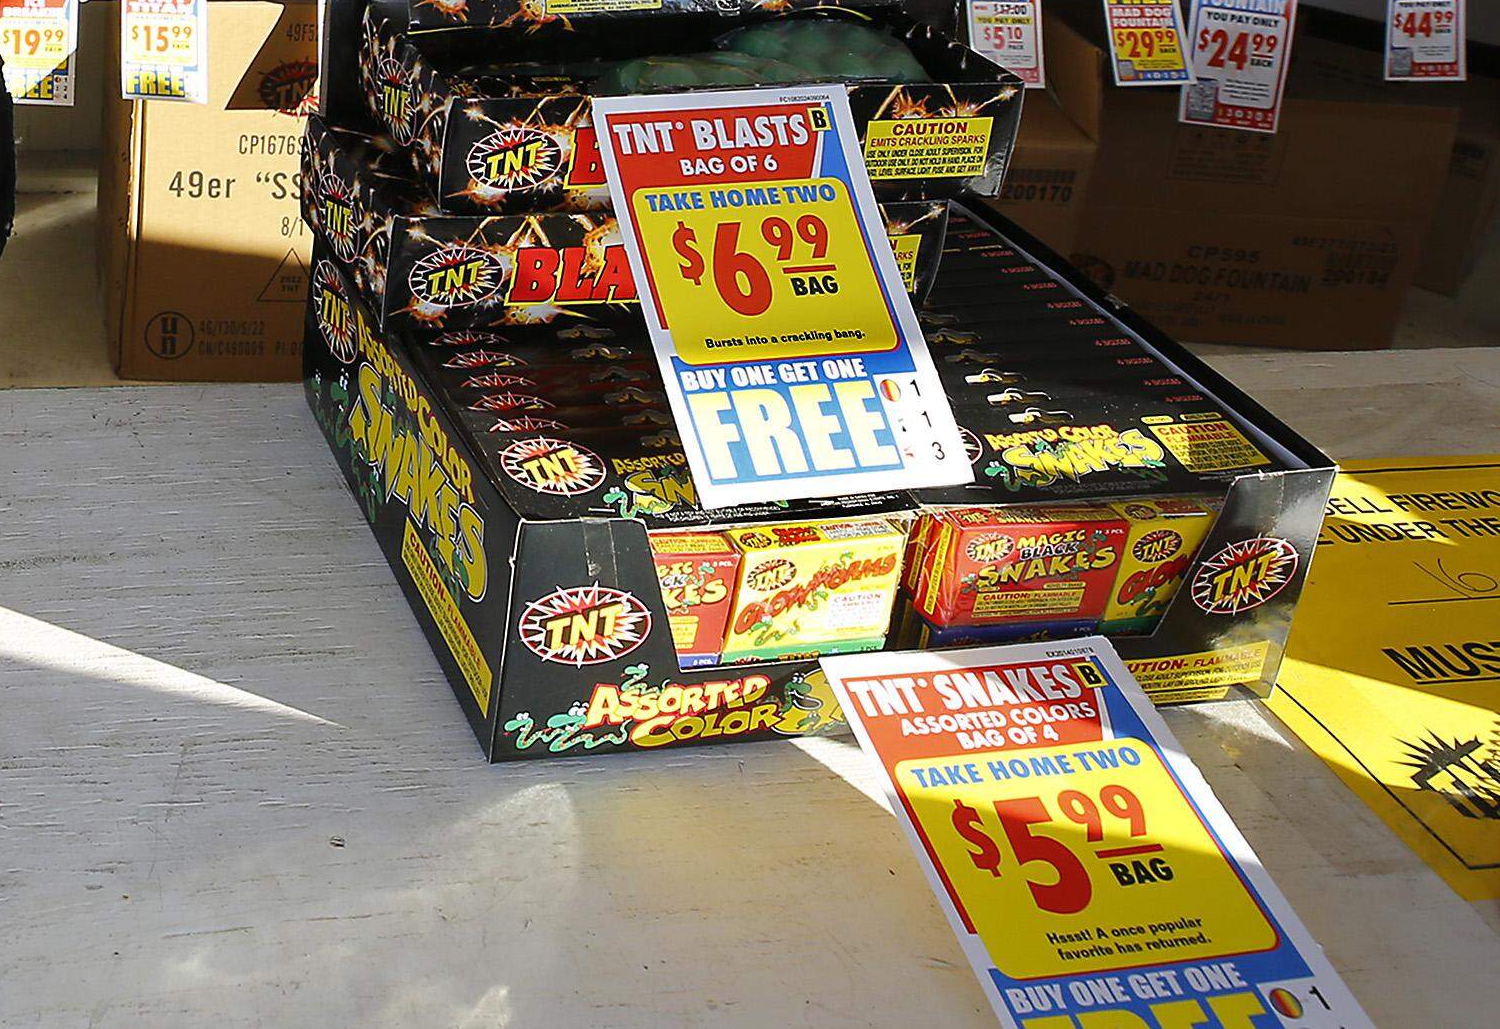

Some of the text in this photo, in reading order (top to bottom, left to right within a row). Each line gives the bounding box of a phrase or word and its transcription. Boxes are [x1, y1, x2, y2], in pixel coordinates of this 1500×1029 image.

[1112, 7, 1171, 18] MAD DOG
[127, 71, 185, 97] FREE
[692, 114, 809, 150] BLASTS
[892, 121, 968, 136] CAUTION
[680, 154, 778, 176] BAG OF 6
[168, 172, 236, 200] 49er
[645, 185, 837, 212] TAKE HOME TWO
[791, 275, 838, 297] BAG
[705, 329, 866, 349] Bursts into a crackling bang.
[679, 358, 868, 393] BUY ONE GET ONE
[687, 379, 900, 482] FREE
[1002, 428, 1166, 487] SNAKES
[350, 362, 487, 603] SNAKES
[1017, 529, 1086, 549] MAGIC
[1330, 517, 1500, 545] UNDER THE
[1021, 541, 1080, 559] BLACK
[979, 544, 1118, 586] SNAKES
[543, 602, 626, 650] TNT
[941, 663, 1083, 709] SNAKES
[587, 675, 770, 728] ASSORTED
[631, 705, 787, 748] COLOR
[900, 700, 1097, 738] ASSORTED COLORS
[956, 724, 1059, 750] BAG OF 4
[911, 746, 1141, 789] TAKE HOME TWO
[1108, 858, 1174, 887] BAG
[1046, 917, 1203, 946] Hssst! A once popular
[1056, 933, 1213, 963] favorite has returned.
[1005, 964, 1247, 1015] BUY ONE GET ONE
